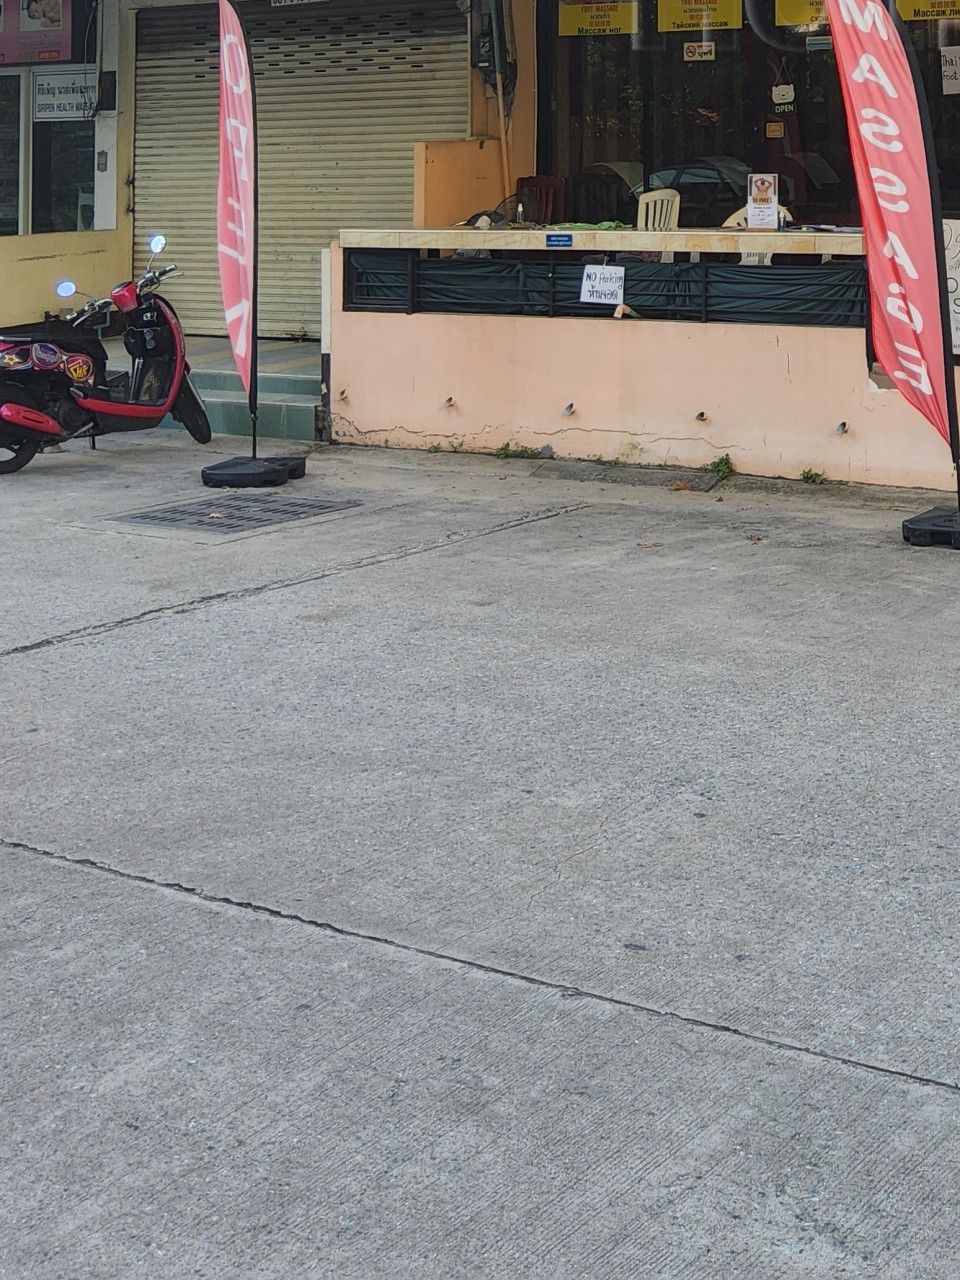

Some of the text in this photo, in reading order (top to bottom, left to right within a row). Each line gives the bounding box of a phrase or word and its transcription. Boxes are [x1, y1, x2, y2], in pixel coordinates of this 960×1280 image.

[913, 8, 947, 18] Массаж
[941, 54, 957, 67] Thai
[943, 69, 959, 81] Foot
[775, 104, 794, 113] OPEN
[585, 272, 597, 282] NO
